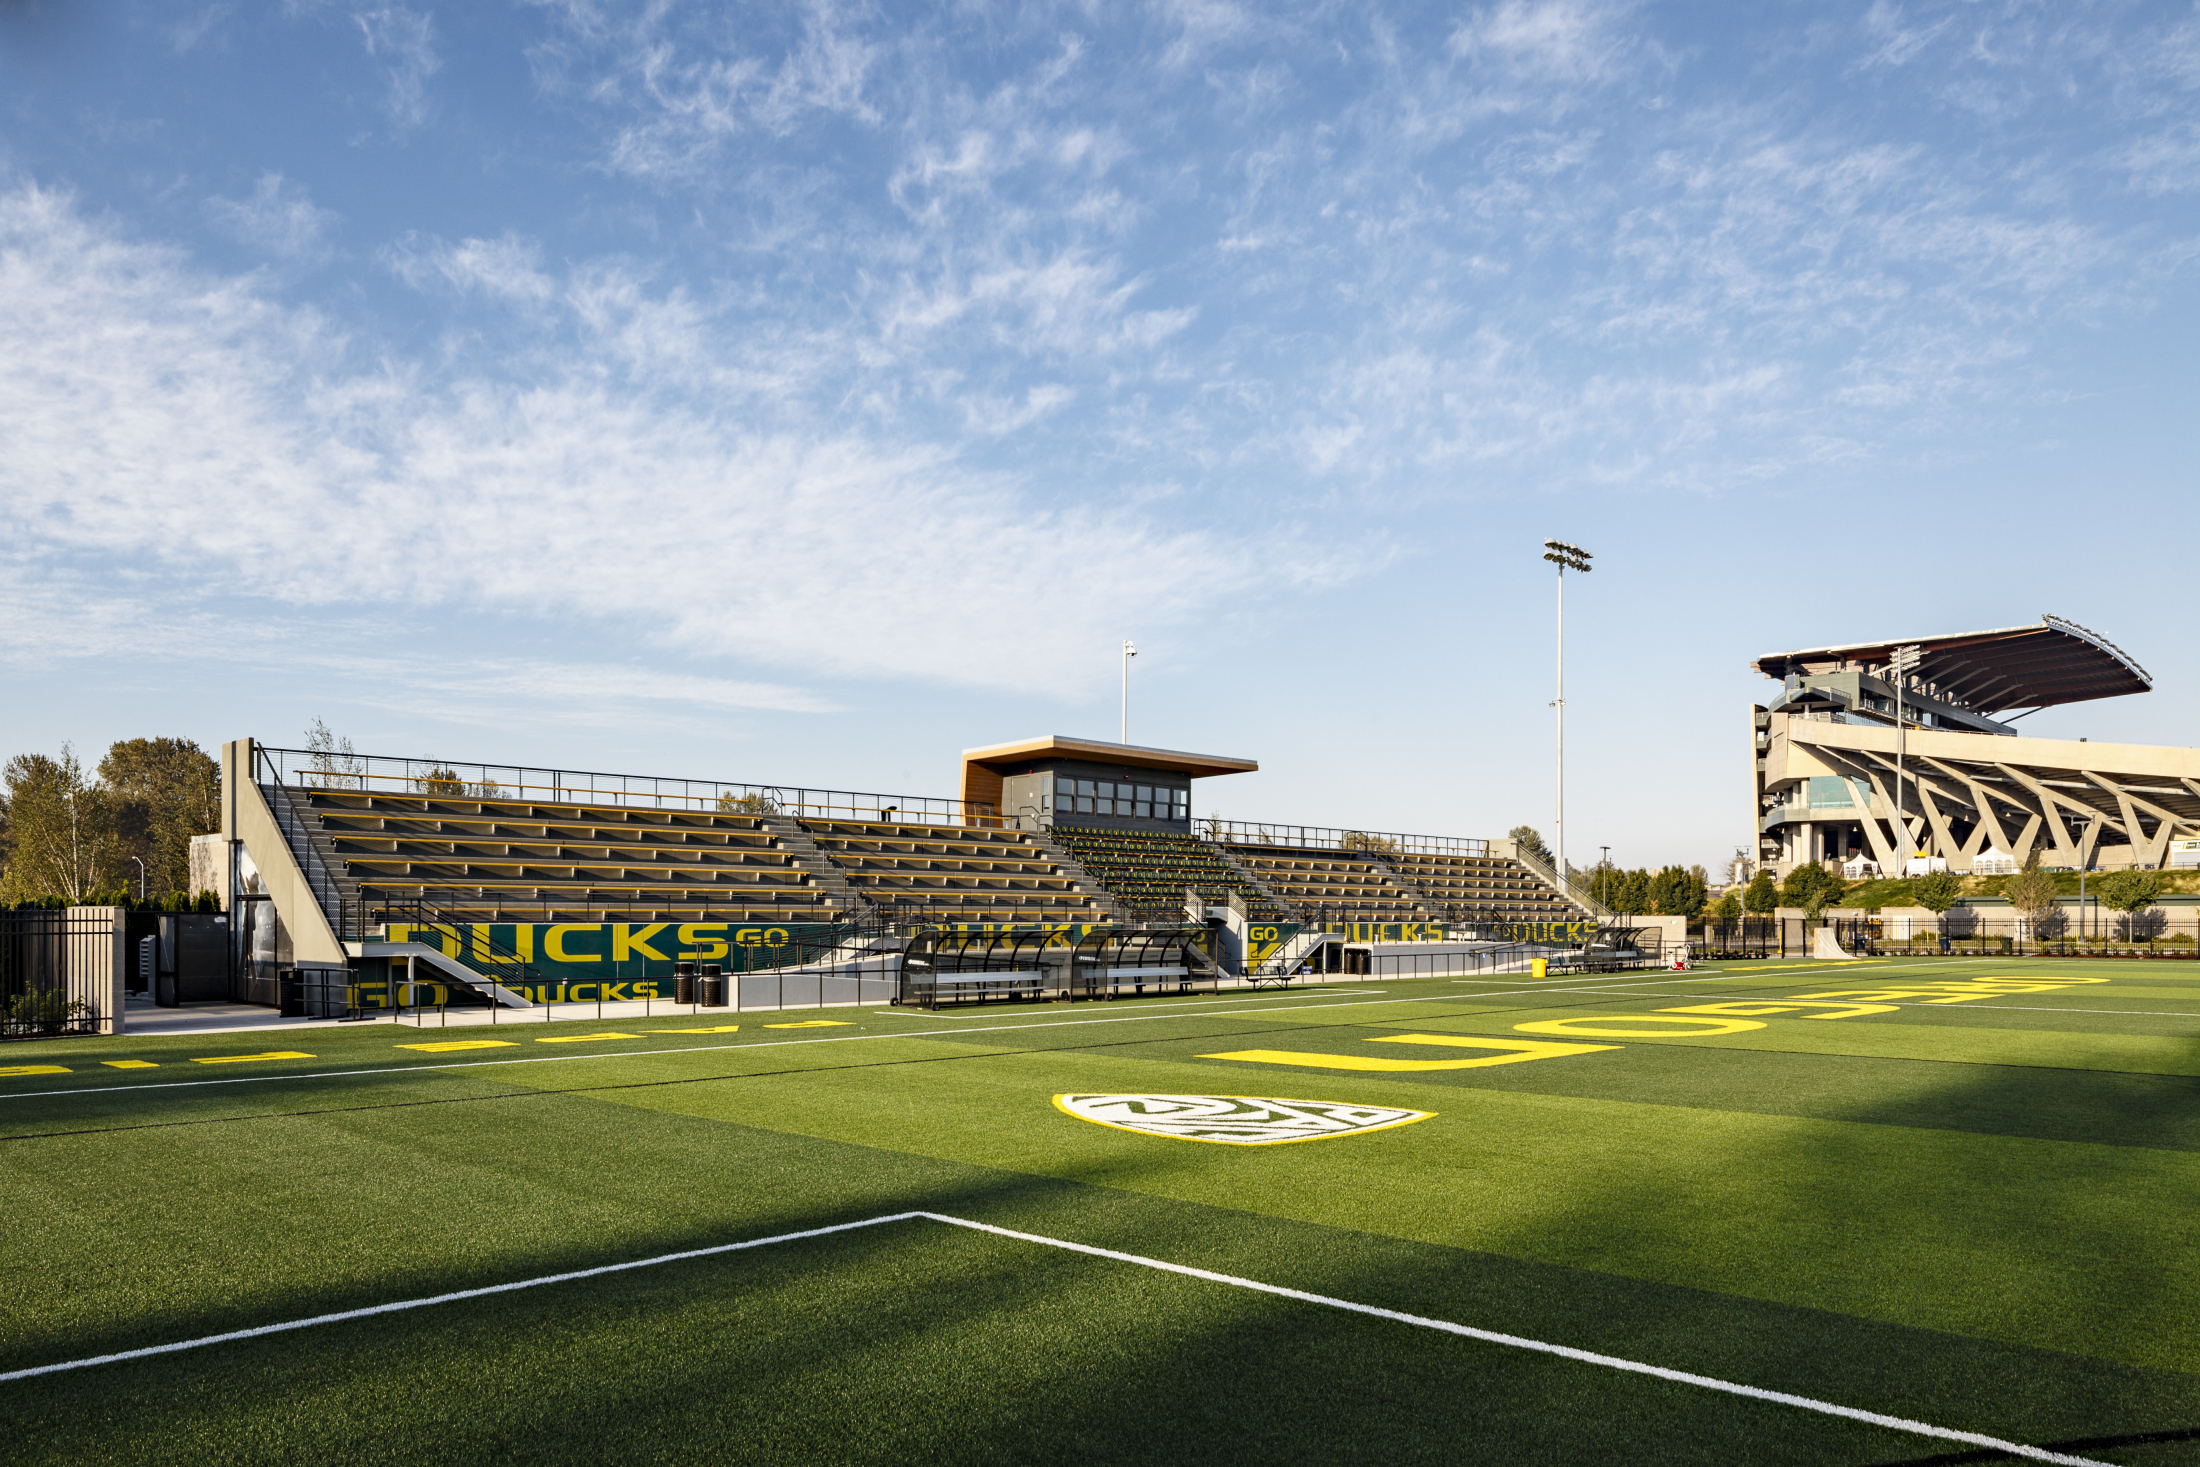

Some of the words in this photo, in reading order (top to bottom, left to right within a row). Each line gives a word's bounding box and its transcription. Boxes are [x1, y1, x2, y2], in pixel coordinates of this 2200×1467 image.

[736, 928, 790, 948] GO
[1249, 926, 1279, 942] GO
[389, 924, 729, 966] DUCKS
